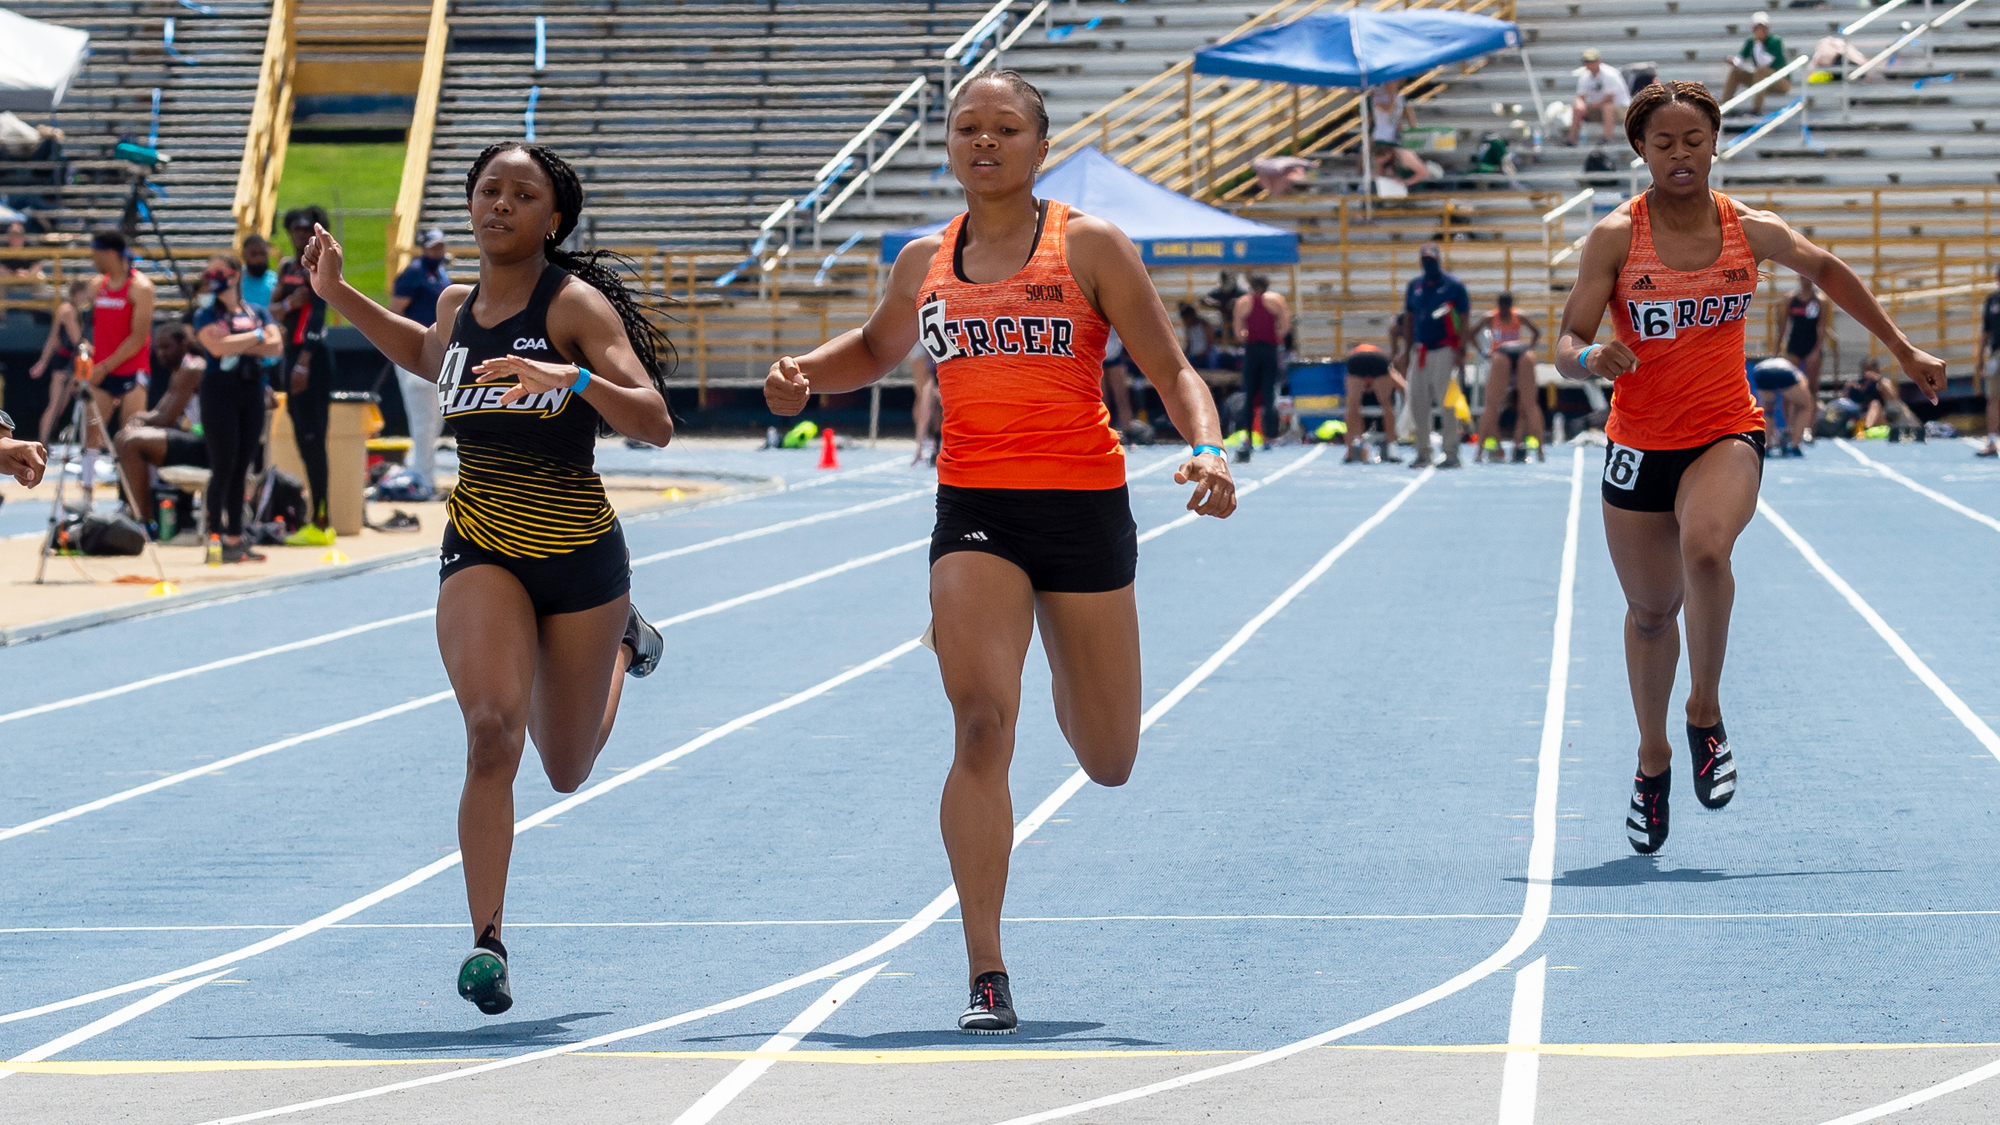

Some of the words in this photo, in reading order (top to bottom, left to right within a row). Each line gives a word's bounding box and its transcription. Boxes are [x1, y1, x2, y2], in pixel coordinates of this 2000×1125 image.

[1026, 283, 1064, 302] SOCON
[1631, 283, 1657, 291] adidas
[922, 305, 947, 359] 5
[944, 316, 1076, 358] ERCER
[1643, 307, 1670, 337] 6
[513, 338, 548, 350] CAA
[439, 352, 459, 401] 4
[1610, 449, 1636, 485] 6
